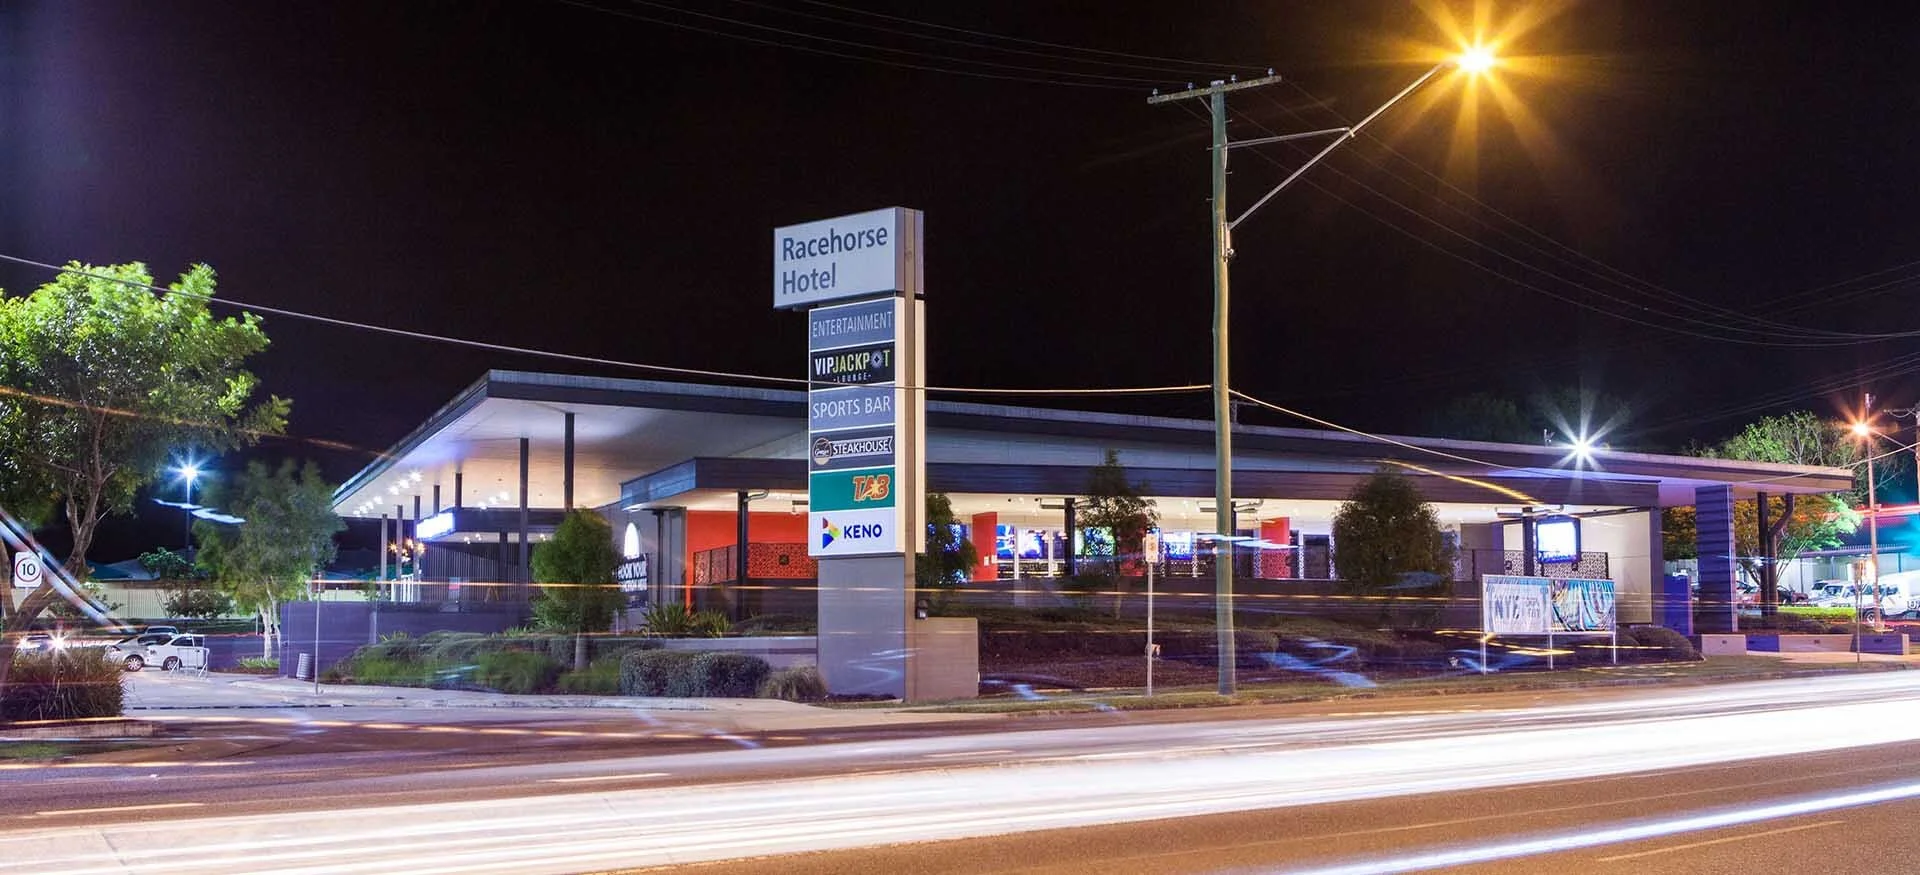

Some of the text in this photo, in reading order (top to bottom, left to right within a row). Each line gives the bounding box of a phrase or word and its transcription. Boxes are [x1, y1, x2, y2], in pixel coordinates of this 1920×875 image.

[783, 226, 888, 263] Racehorse
[783, 262, 836, 295] Hotel
[812, 311, 893, 338] ENTERTAINMENT
[812, 395, 891, 420] SPORTS BAR
[832, 440, 889, 455] STEAKHOUSE
[852, 474, 891, 502] TAB
[844, 524, 883, 540] KENO
[22, 563, 36, 576] 10
